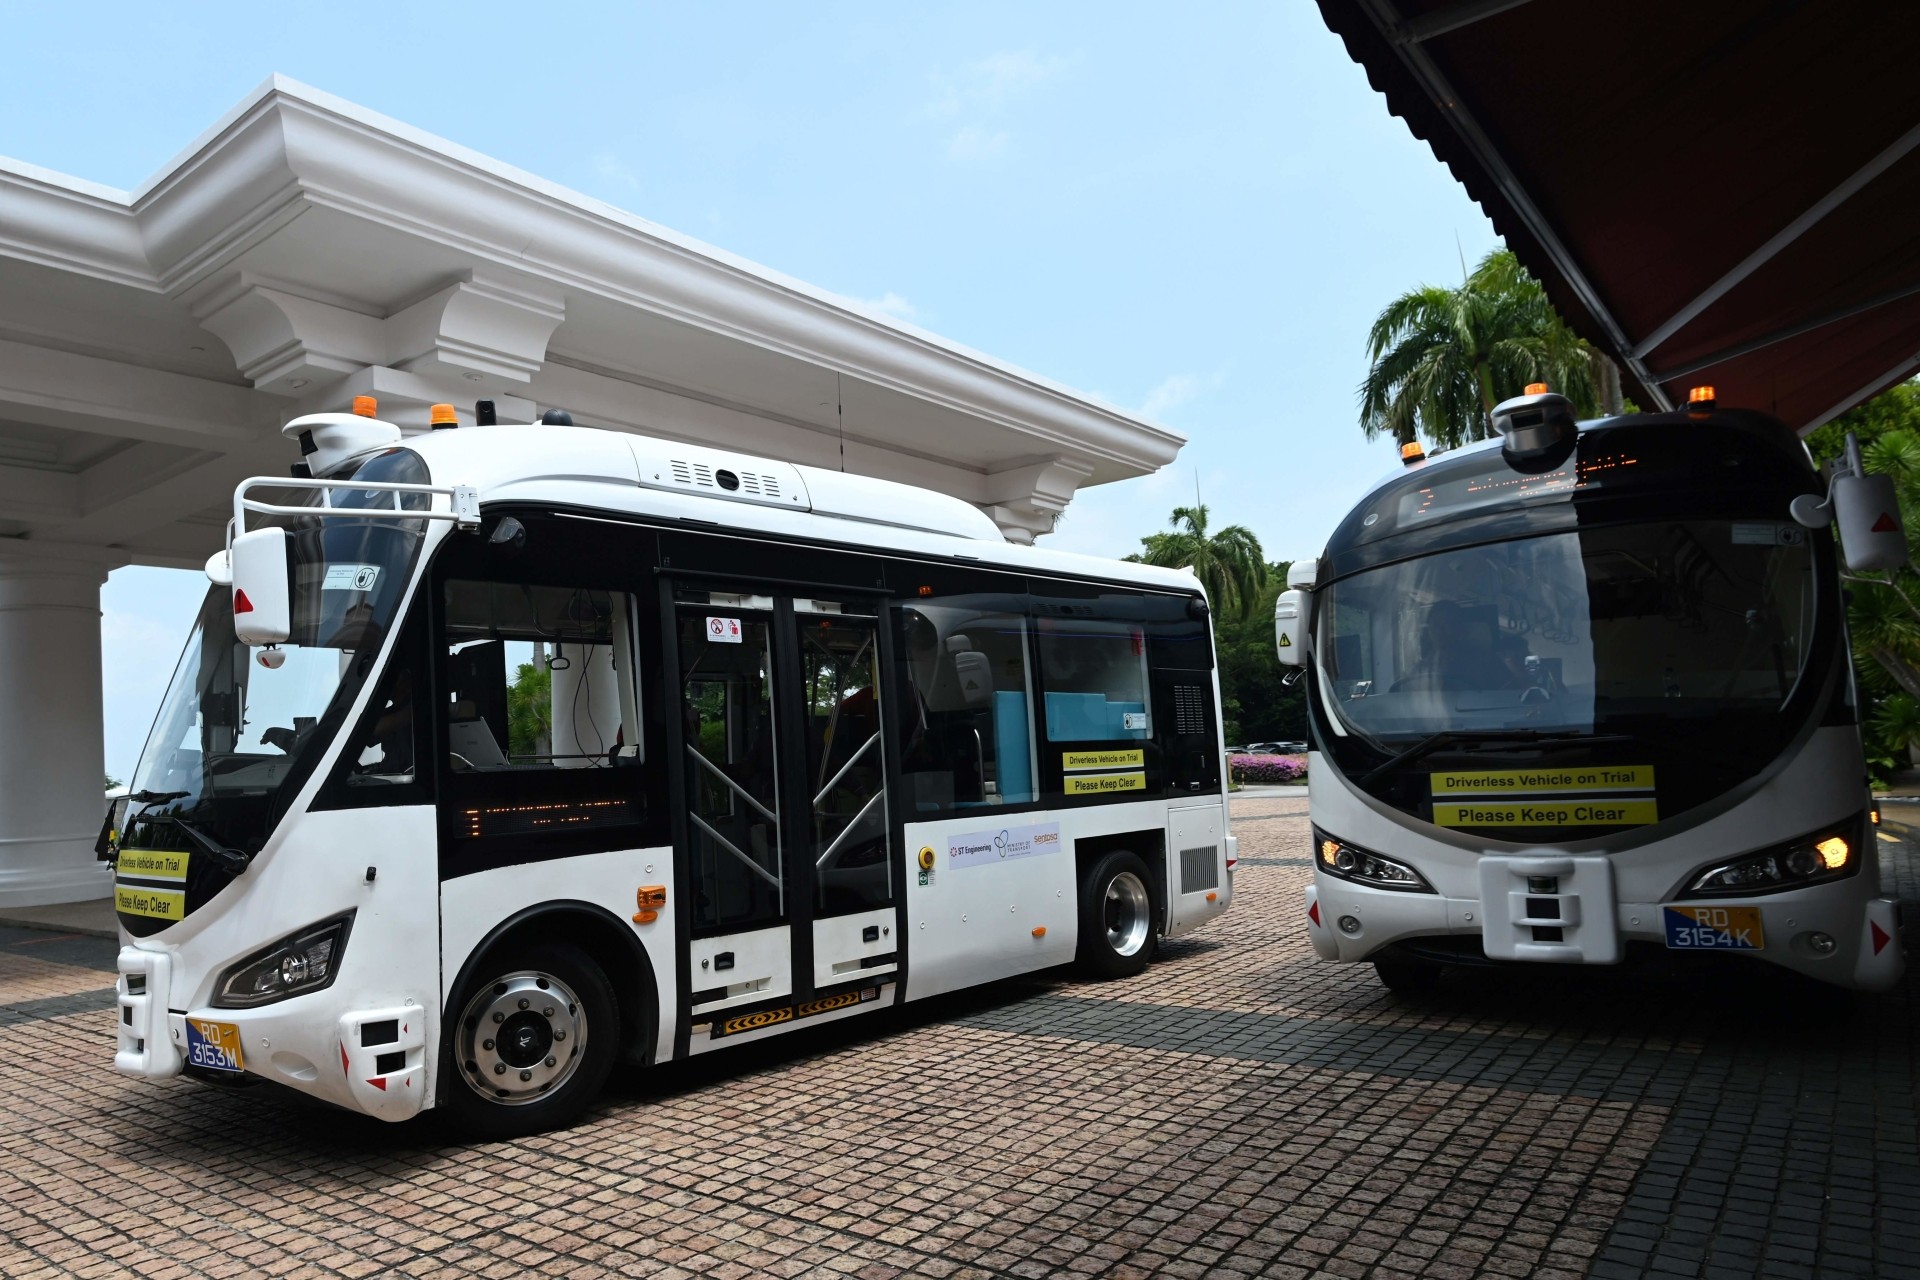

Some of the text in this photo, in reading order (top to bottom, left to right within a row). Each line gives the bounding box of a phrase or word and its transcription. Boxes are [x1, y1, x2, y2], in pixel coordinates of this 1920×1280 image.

[1069, 756, 1098, 764] Driverless
[1099, 755, 1118, 763] Vehicle
[1127, 753, 1138, 761] Trial
[1075, 777, 1136, 791] Please Keep Clear
[1446, 770, 1635, 788] Driverless Vehicle on Trial
[1458, 806, 1626, 825] Please Keep Clear
[1033, 833, 1058, 843] sentosa
[957, 844, 992, 855] ST Engineering
[119, 856, 180, 871] Driverless Vehicle on Trial
[119, 893, 171, 914] Please Keep Clear
[1695, 908, 1729, 927] RD
[1675, 928, 1753, 947] 3154K
[201, 1023, 220, 1044] RD
[193, 1043, 237, 1067] 3153M
